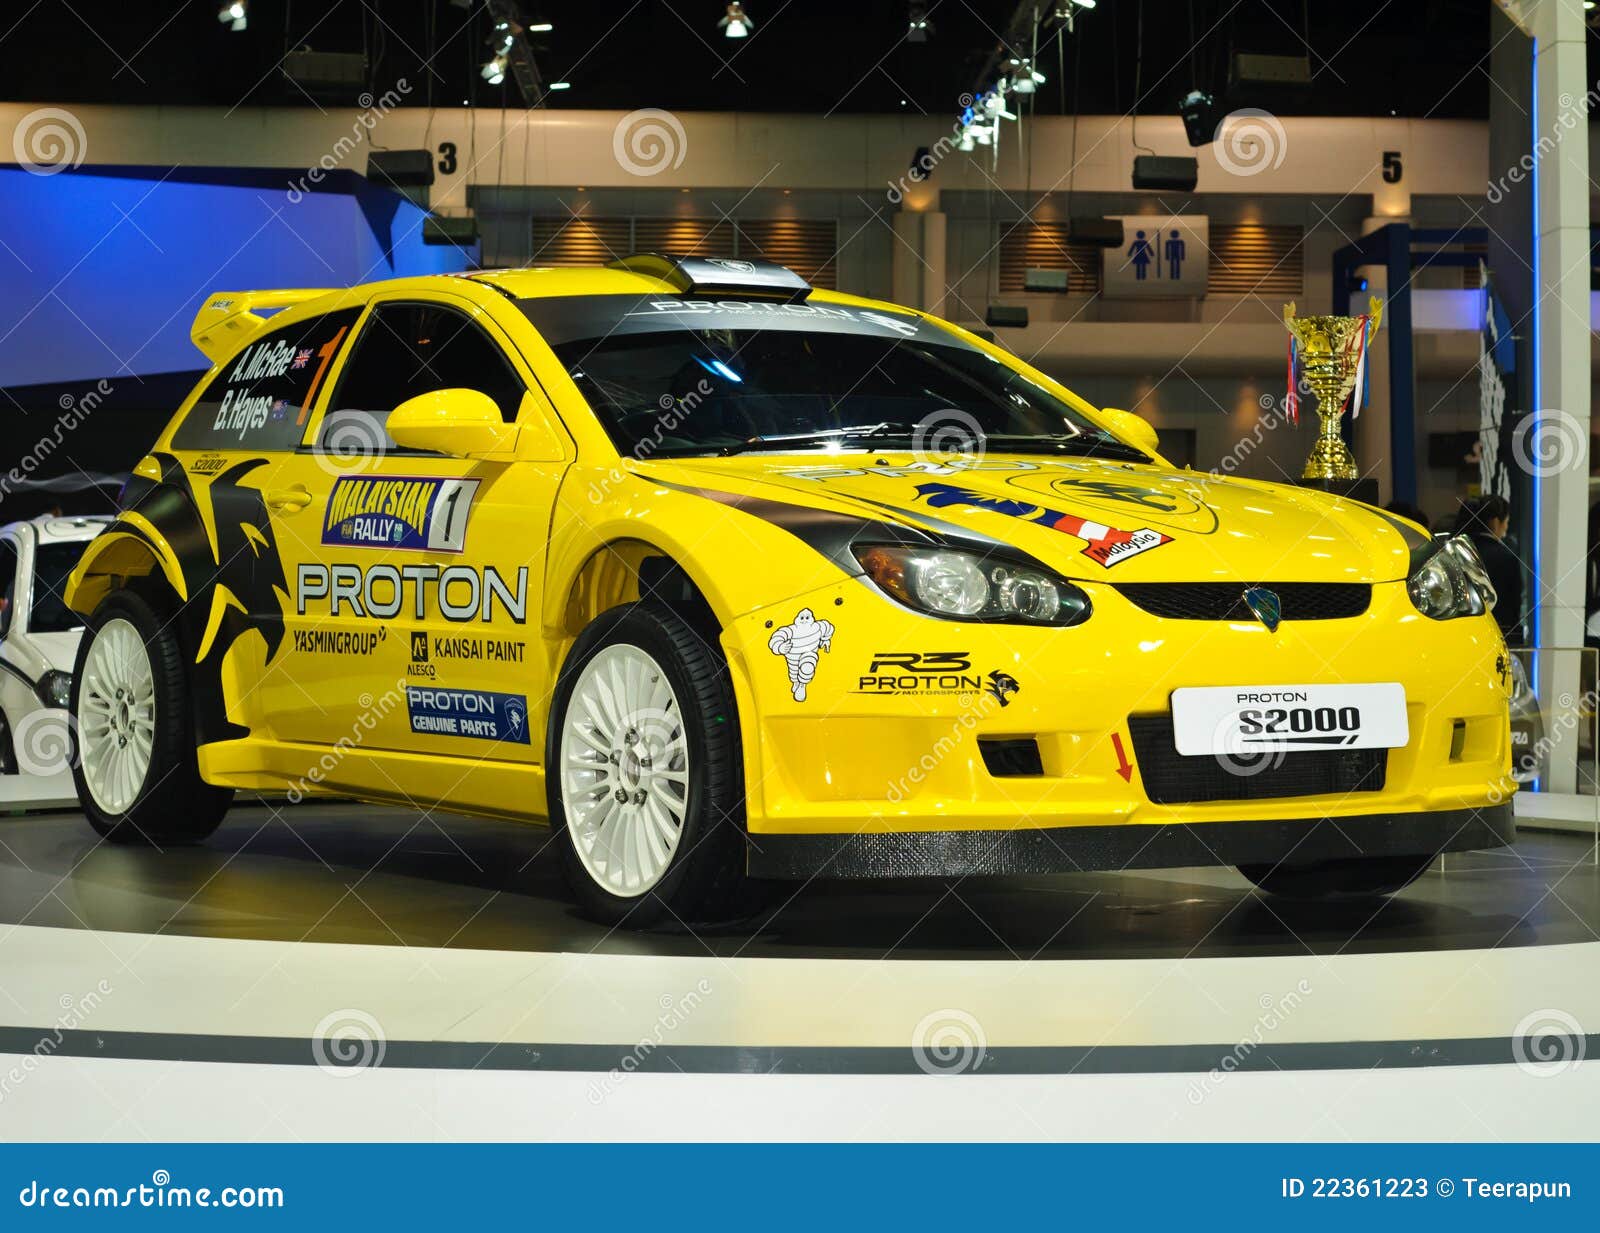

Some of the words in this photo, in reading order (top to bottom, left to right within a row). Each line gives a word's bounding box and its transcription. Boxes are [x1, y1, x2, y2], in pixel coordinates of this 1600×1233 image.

[438, 142, 457, 175] 3
[1382, 151, 1403, 184] 5
[649, 300, 860, 322] PROTON
[228, 340, 296, 383] A.McRae
[296, 326, 348, 426] 1
[213, 388, 273, 440] B.Hayes
[327, 479, 436, 537] MALAYSIAN
[447, 486, 463, 542] 1
[353, 517, 394, 542] RALLY
[1093, 533, 1156, 560] Malaysia
[297, 563, 529, 624] PROTON
[293, 629, 377, 656] YASMINGROUP
[434, 637, 483, 660] KANSAI
[487, 641, 525, 663] PAINT
[407, 664, 435, 677] ALESCO
[869, 652, 972, 673] R3
[859, 675, 981, 690] PROTON
[408, 687, 496, 714] PROTON
[1237, 692, 1307, 703] PROTON
[413, 714, 458, 733] GENUINE
[461, 719, 497, 737] PARTS
[1239, 706, 1361, 735] S2000
